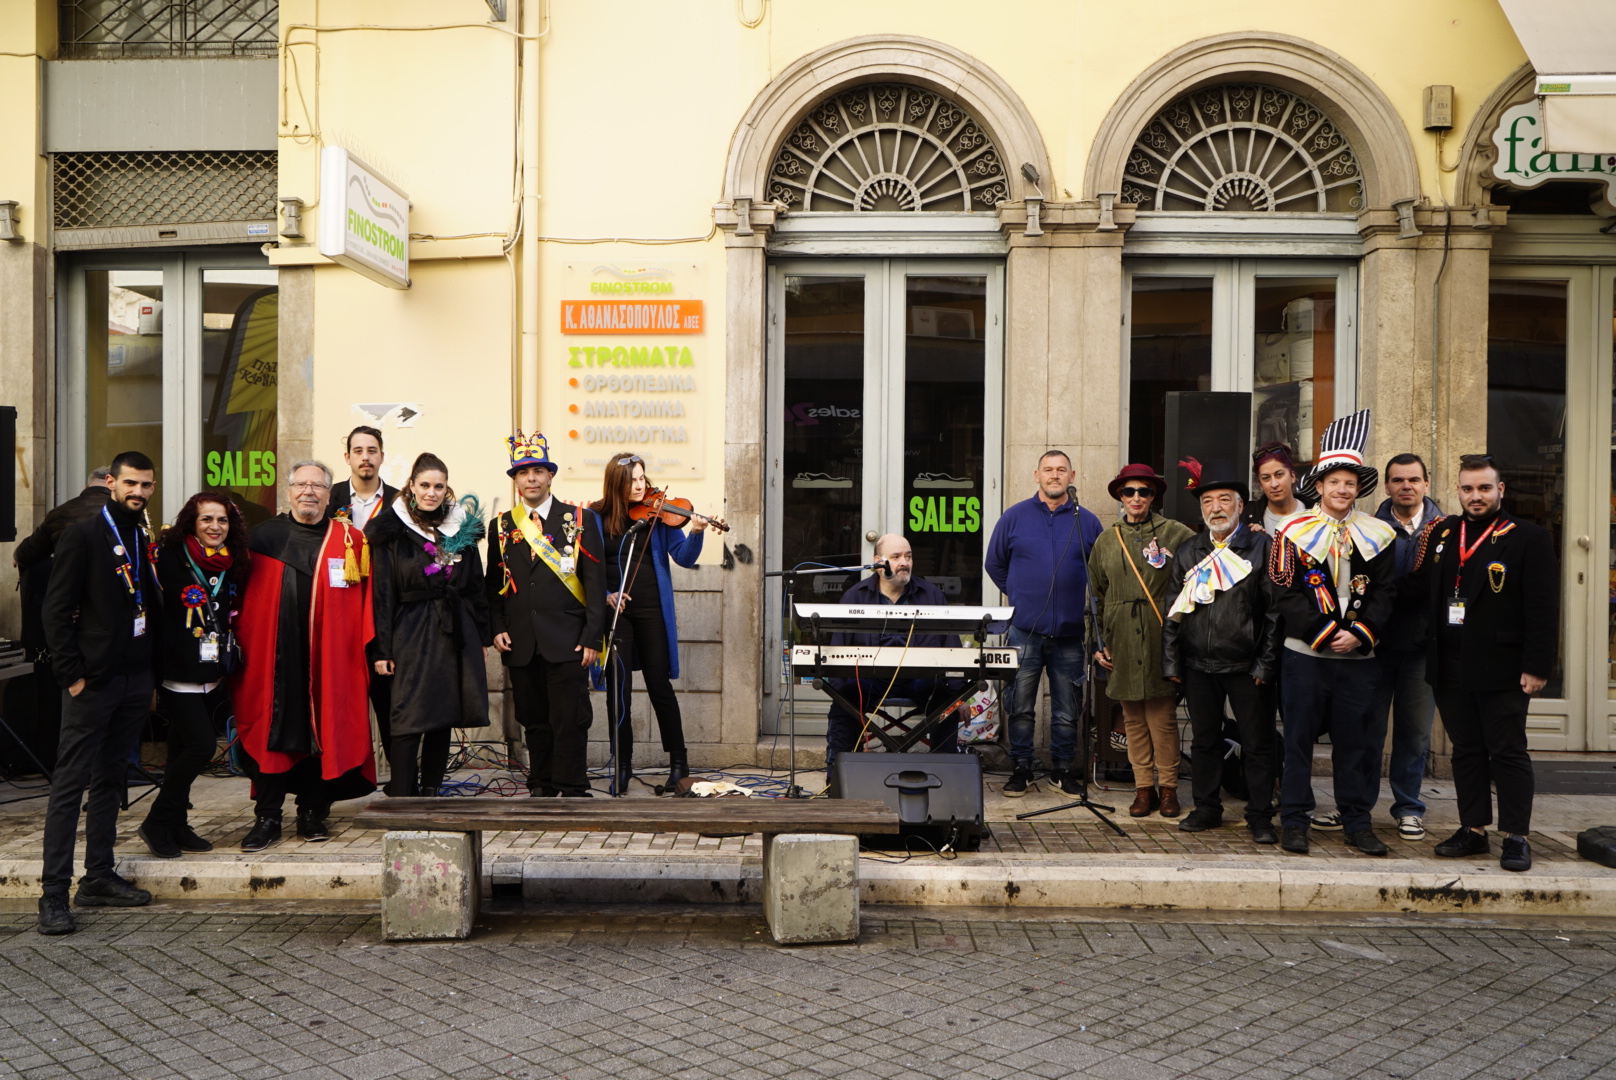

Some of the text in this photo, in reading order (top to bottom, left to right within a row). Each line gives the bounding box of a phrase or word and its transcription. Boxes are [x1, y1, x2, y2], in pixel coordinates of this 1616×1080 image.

[347, 208, 405, 262] FINOSTROM
[590, 281, 673, 293] FINOSTROM
[565, 304, 699, 329] Κ. ΑΘΑΝΑΣΟΠΟΥΛΟΣ ΑΒΕΕ
[567, 345, 694, 367] ΣΤΡΩΜΑΤΑ
[583, 374, 696, 392] ΟΡΘΟΠΕΔΙΚΑ
[583, 400, 685, 418] ΑΝΑΤΟΜΙΚΑ
[583, 425, 688, 442] ΟΙΚΟΛΟΓΙΚΑ
[206, 450, 276, 487] SALES
[909, 496, 981, 533] SALES
